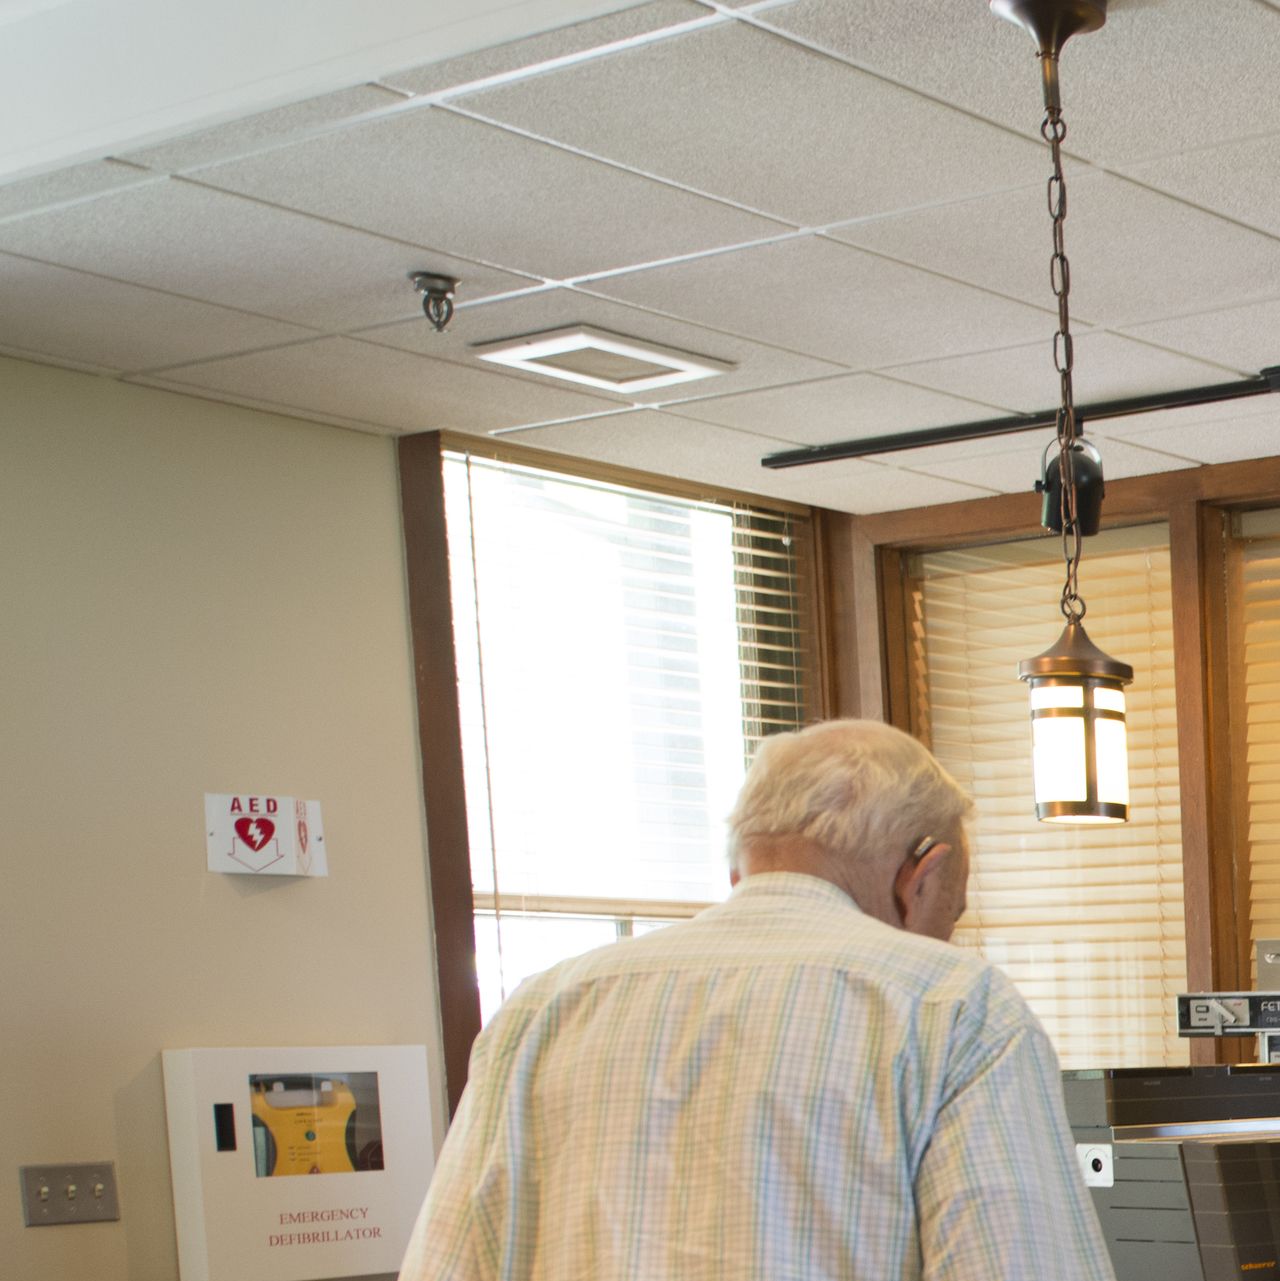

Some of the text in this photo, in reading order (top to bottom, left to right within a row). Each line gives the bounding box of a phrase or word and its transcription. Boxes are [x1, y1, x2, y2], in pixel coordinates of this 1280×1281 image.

[230, 796, 279, 815] AED
[279, 1206, 370, 1227] EMERGENCY
[268, 1226, 383, 1249] DEFIBRILLATOR
